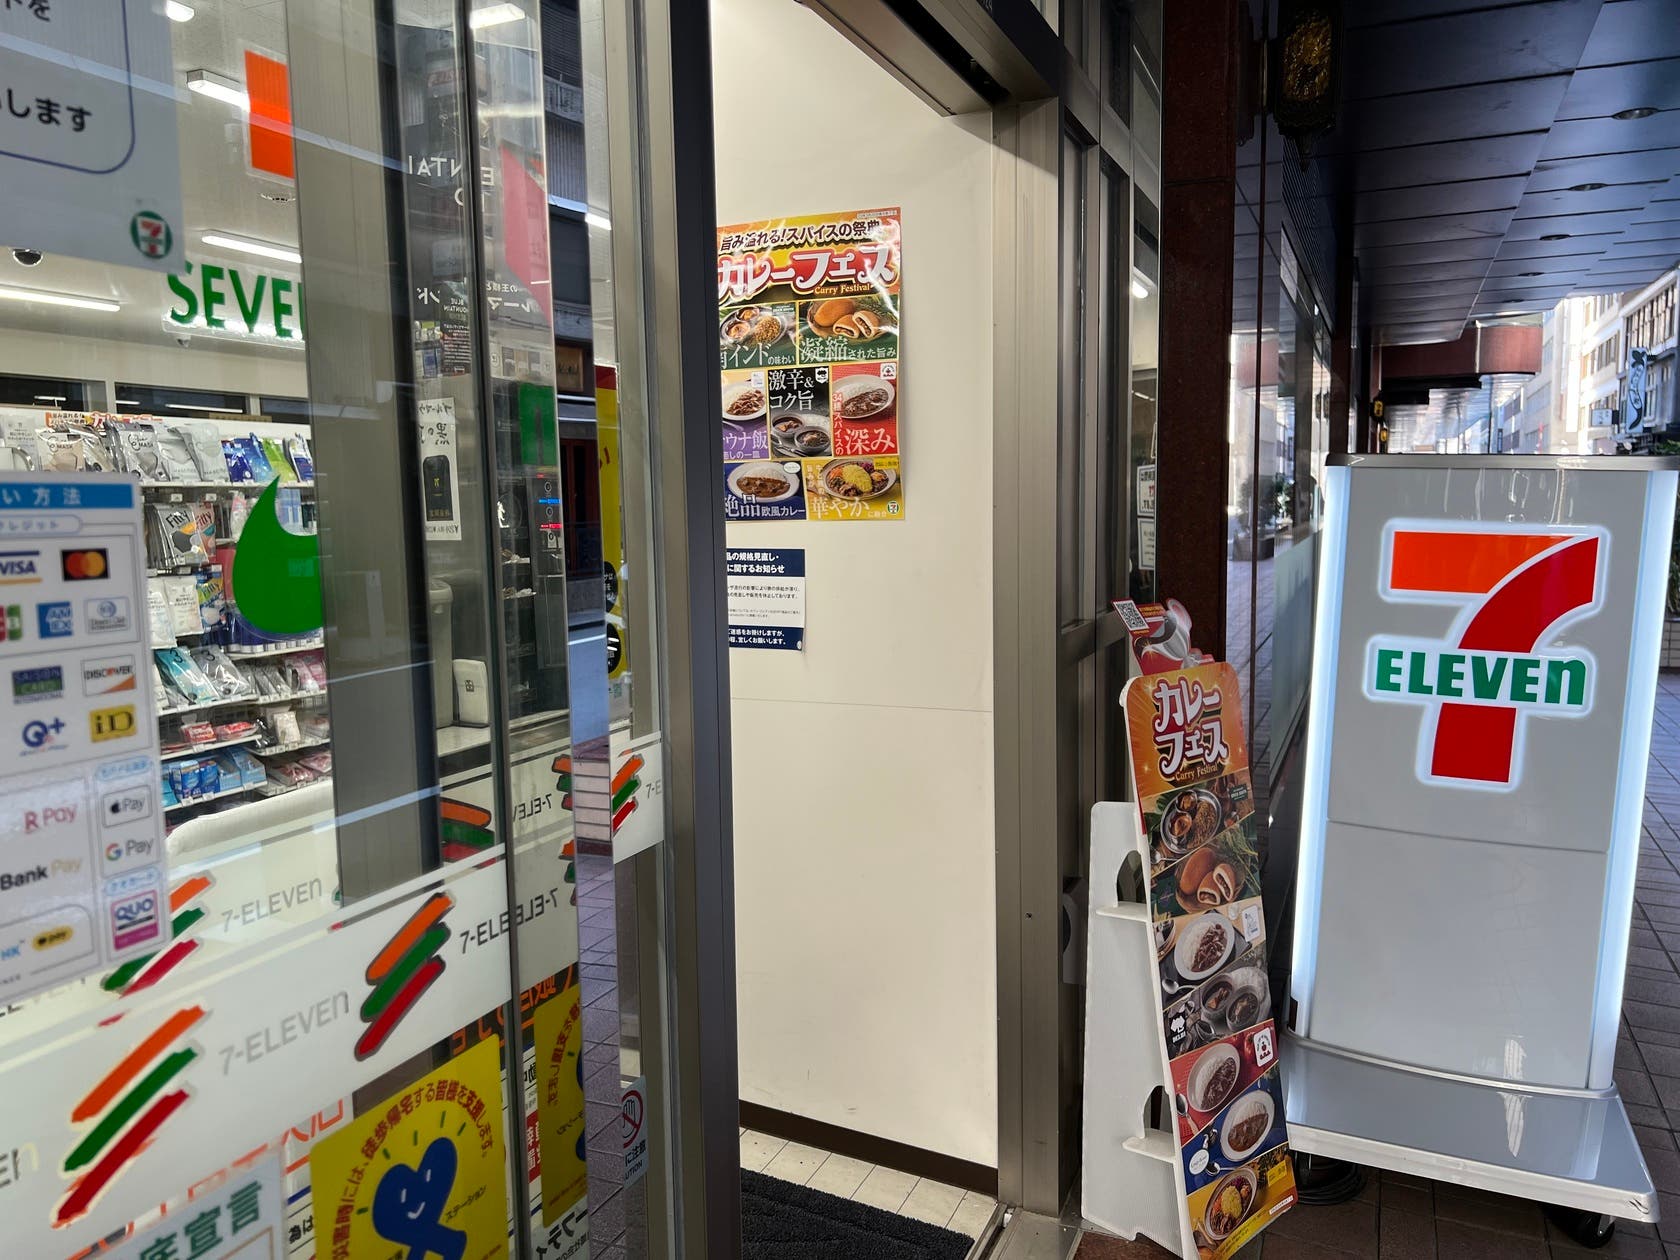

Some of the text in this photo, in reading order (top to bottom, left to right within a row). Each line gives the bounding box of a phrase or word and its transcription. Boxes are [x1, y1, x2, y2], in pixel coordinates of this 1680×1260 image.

[718, 245, 895, 297] カレーフェス
[167, 260, 304, 339] SEVE
[814, 283, 871, 295] Curry Festival
[769, 390, 815, 411] コク旨
[723, 430, 768, 450] ウナ飯
[844, 427, 896, 455] 深み
[1390, 531, 1599, 783] 7
[1153, 679, 1221, 733] カレー
[1155, 720, 1229, 775] フェス
[1174, 764, 1219, 781] Curry Festival
[42, 804, 77, 827] Pay
[122, 798, 145, 812] Pay
[125, 839, 154, 857] Pay
[116, 898, 154, 921] QUO
